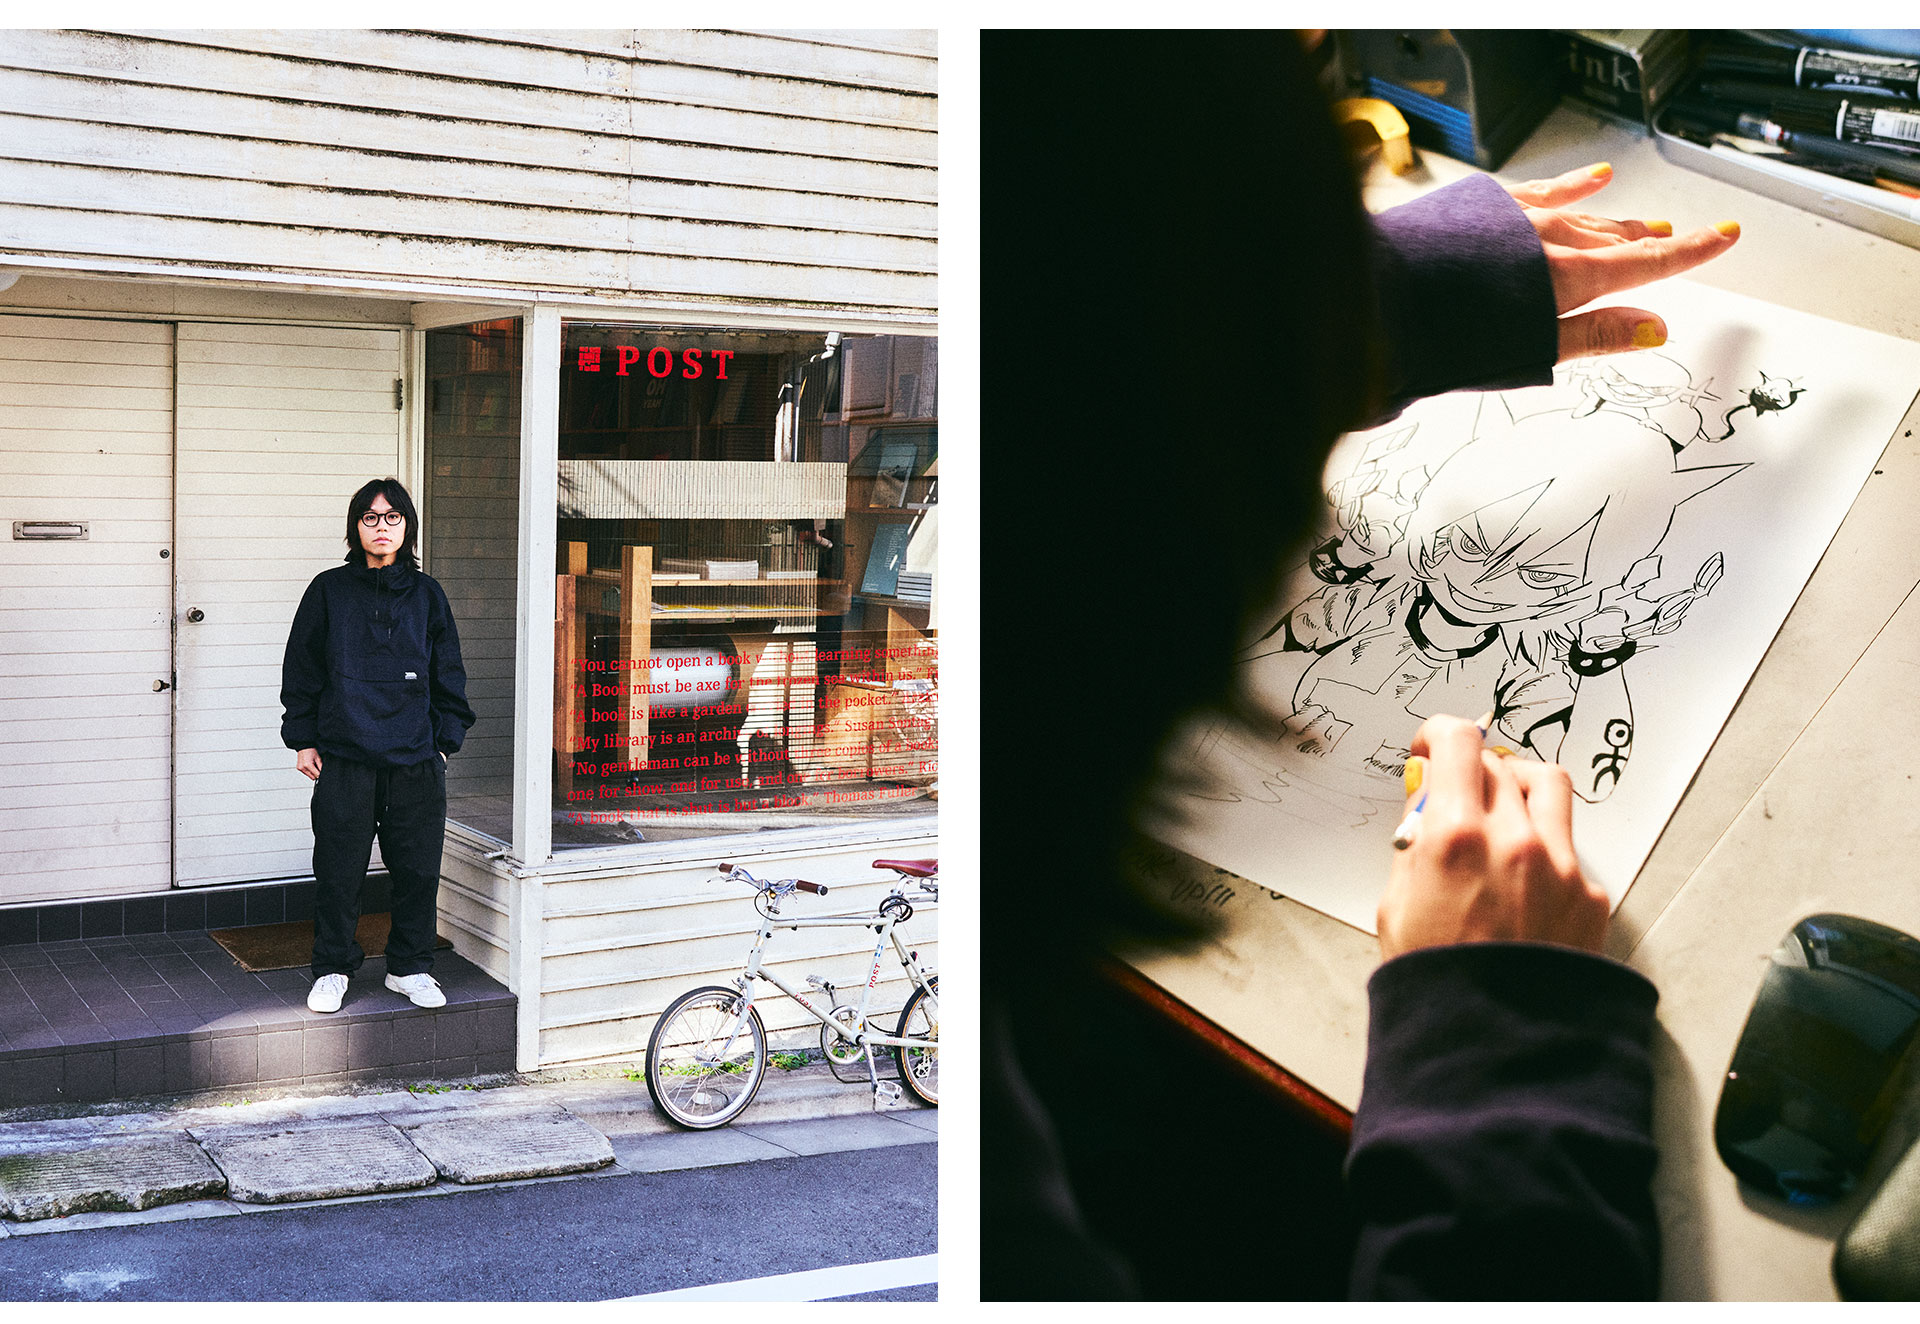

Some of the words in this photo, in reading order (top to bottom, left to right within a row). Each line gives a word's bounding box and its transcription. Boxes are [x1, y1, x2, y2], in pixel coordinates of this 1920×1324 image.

[1568, 40, 1641, 94] ink
[616, 346, 734, 379] POST
[610, 657, 662, 671] cannot
[667, 656, 701, 671] open
[705, 656, 713, 666] a
[718, 651, 751, 666] book
[815, 646, 871, 663] learning
[592, 681, 628, 697] Book
[632, 681, 670, 695] must
[675, 679, 692, 692] be
[696, 680, 720, 691] axe
[725, 676, 745, 690] for
[824, 674, 846, 685] sea
[849, 668, 894, 683] within
[591, 707, 627, 722] book
[631, 706, 644, 720] is
[649, 704, 676, 719] like
[680, 707, 688, 717] a
[692, 701, 742, 720] garden
[818, 695, 841, 709] the
[604, 733, 657, 749] library
[660, 731, 673, 744] is
[677, 732, 695, 743] an
[844, 719, 884, 732] Susan
[888, 716, 931, 731] Sontag
[601, 757, 680, 777] gentleman
[683, 757, 709, 768] can
[713, 752, 731, 765] be
[835, 741, 875, 759] copies
[879, 739, 892, 753] of
[894, 742, 902, 752] a
[567, 789, 594, 801] one
[599, 784, 620, 799] for
[624, 782, 666, 796] show,
[670, 781, 696, 793] one
[700, 777, 721, 791] for
[725, 777, 753, 789] use,
[758, 771, 783, 785] and
[589, 808, 625, 824] book
[629, 806, 661, 820] that
[664, 804, 678, 818] is
[681, 802, 714, 817] shut
[717, 800, 730, 813] is
[733, 798, 758, 812] but
[761, 799, 769, 809] a
[823, 790, 875, 804] Thomas
[879, 784, 918, 799] Fuller
[868, 962, 881, 989] POST
